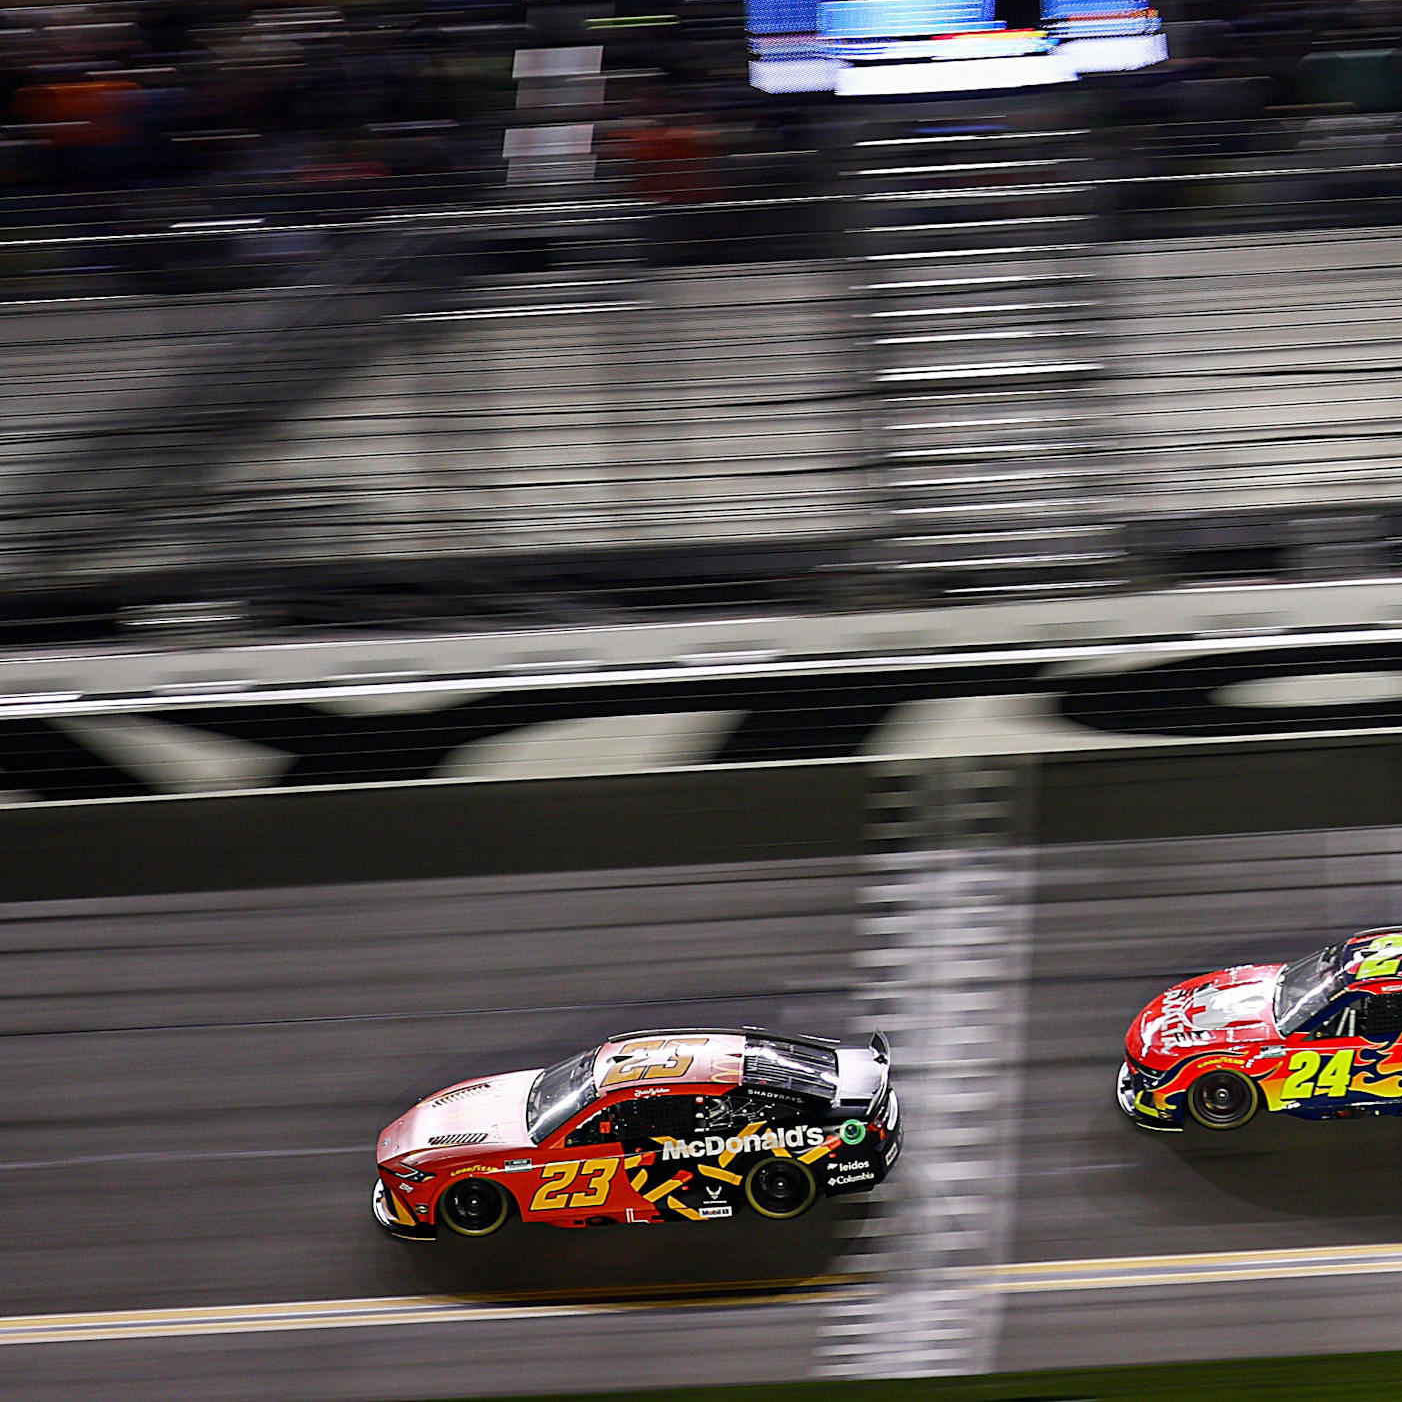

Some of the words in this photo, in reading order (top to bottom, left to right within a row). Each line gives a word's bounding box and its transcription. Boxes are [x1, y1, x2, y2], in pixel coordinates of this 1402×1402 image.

[1280, 1049, 1355, 1099] 24
[661, 1124, 824, 1161] McDonald's
[836, 1172, 875, 1186] Columbia
[839, 1160, 870, 1172] leidos
[529, 1157, 622, 1213] 23
